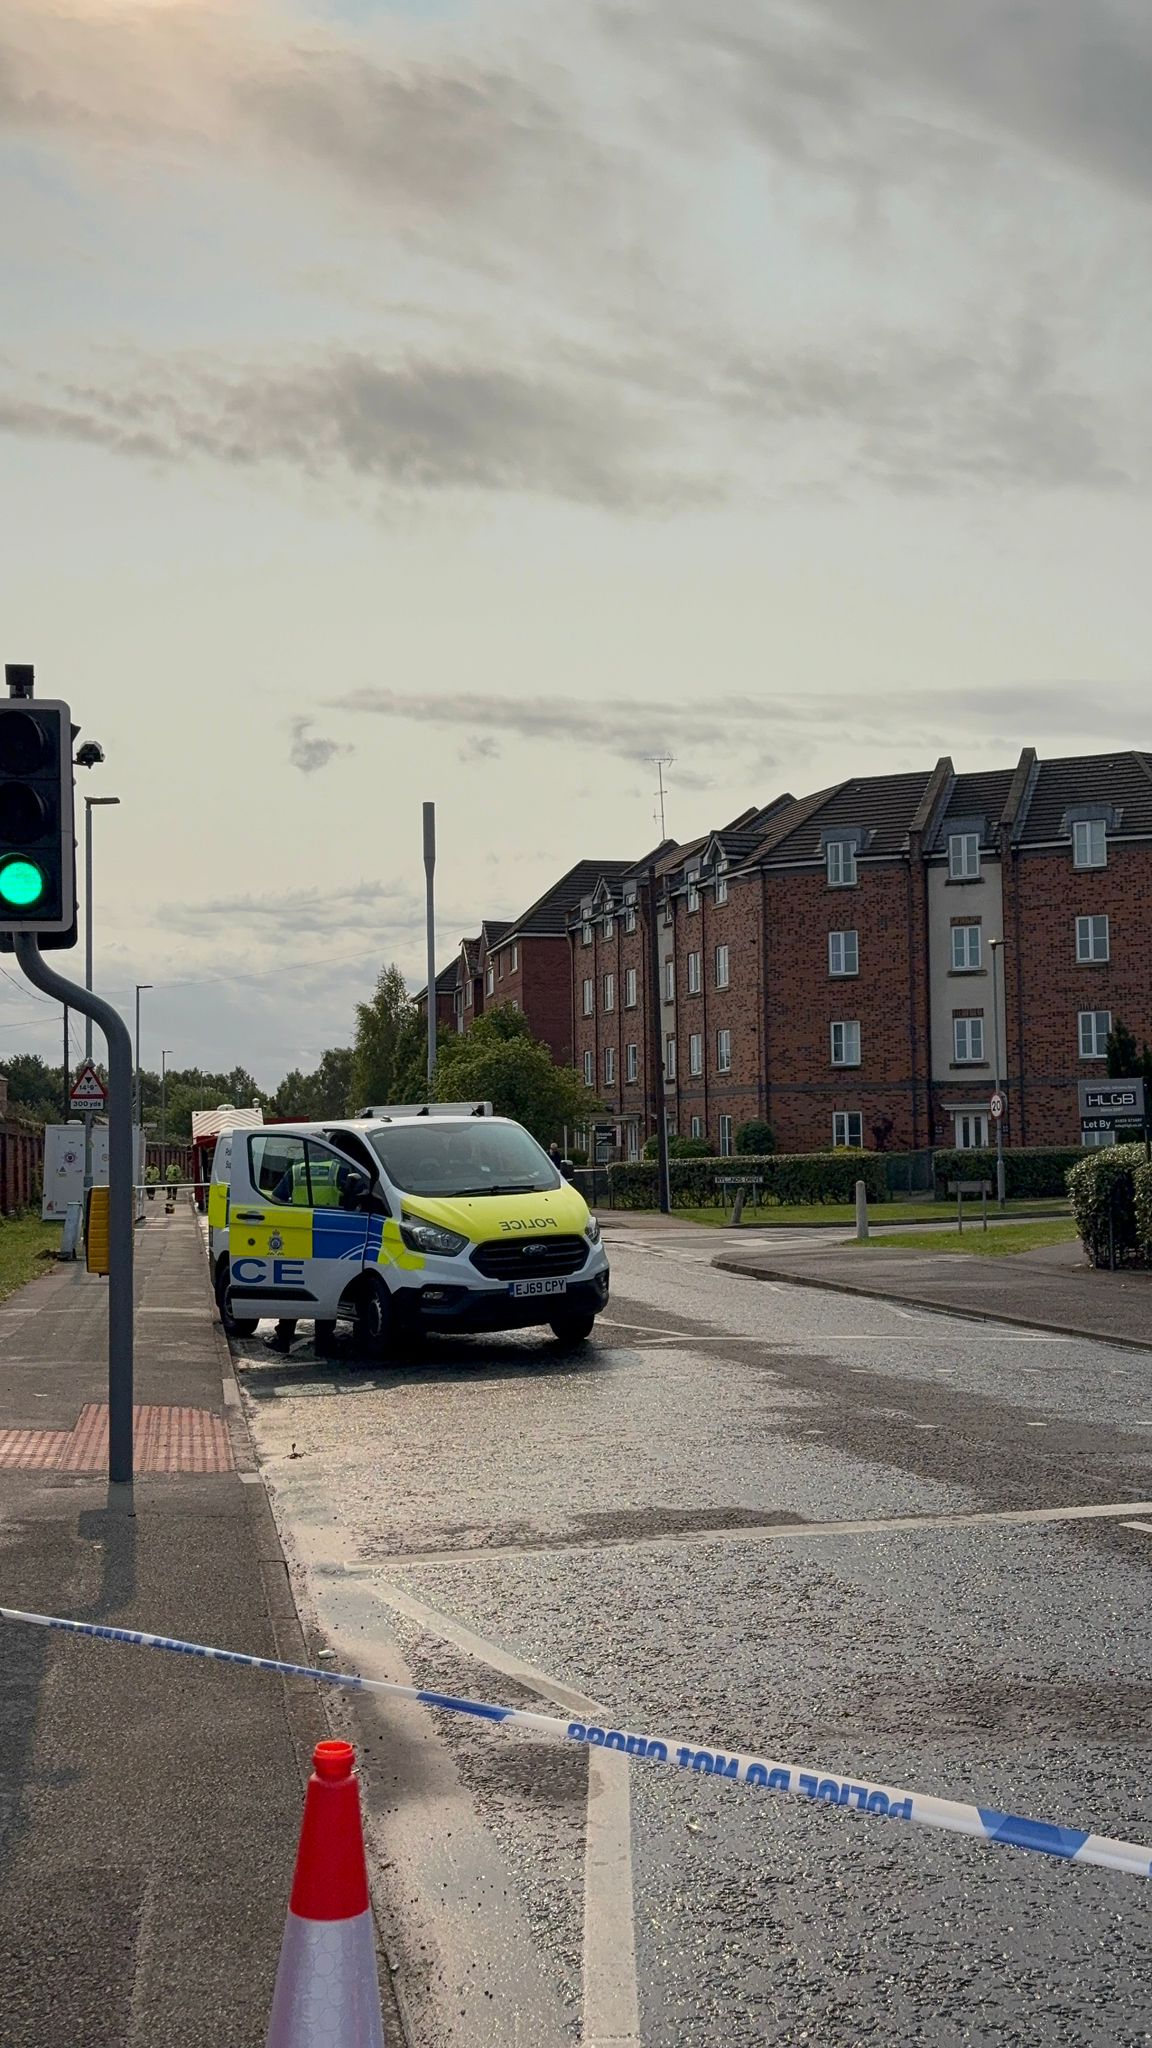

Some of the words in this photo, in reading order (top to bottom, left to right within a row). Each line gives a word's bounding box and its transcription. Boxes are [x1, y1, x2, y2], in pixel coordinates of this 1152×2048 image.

[992, 1100, 1001, 1111] 20
[1088, 1093, 1134, 1106] HLGB
[1083, 1121, 1098, 1129] Let
[1099, 1120, 1111, 1129] By
[231, 1258, 305, 1285] CE
[515, 1282, 543, 1295] EJ69
[545, 1279, 565, 1292] CPY
